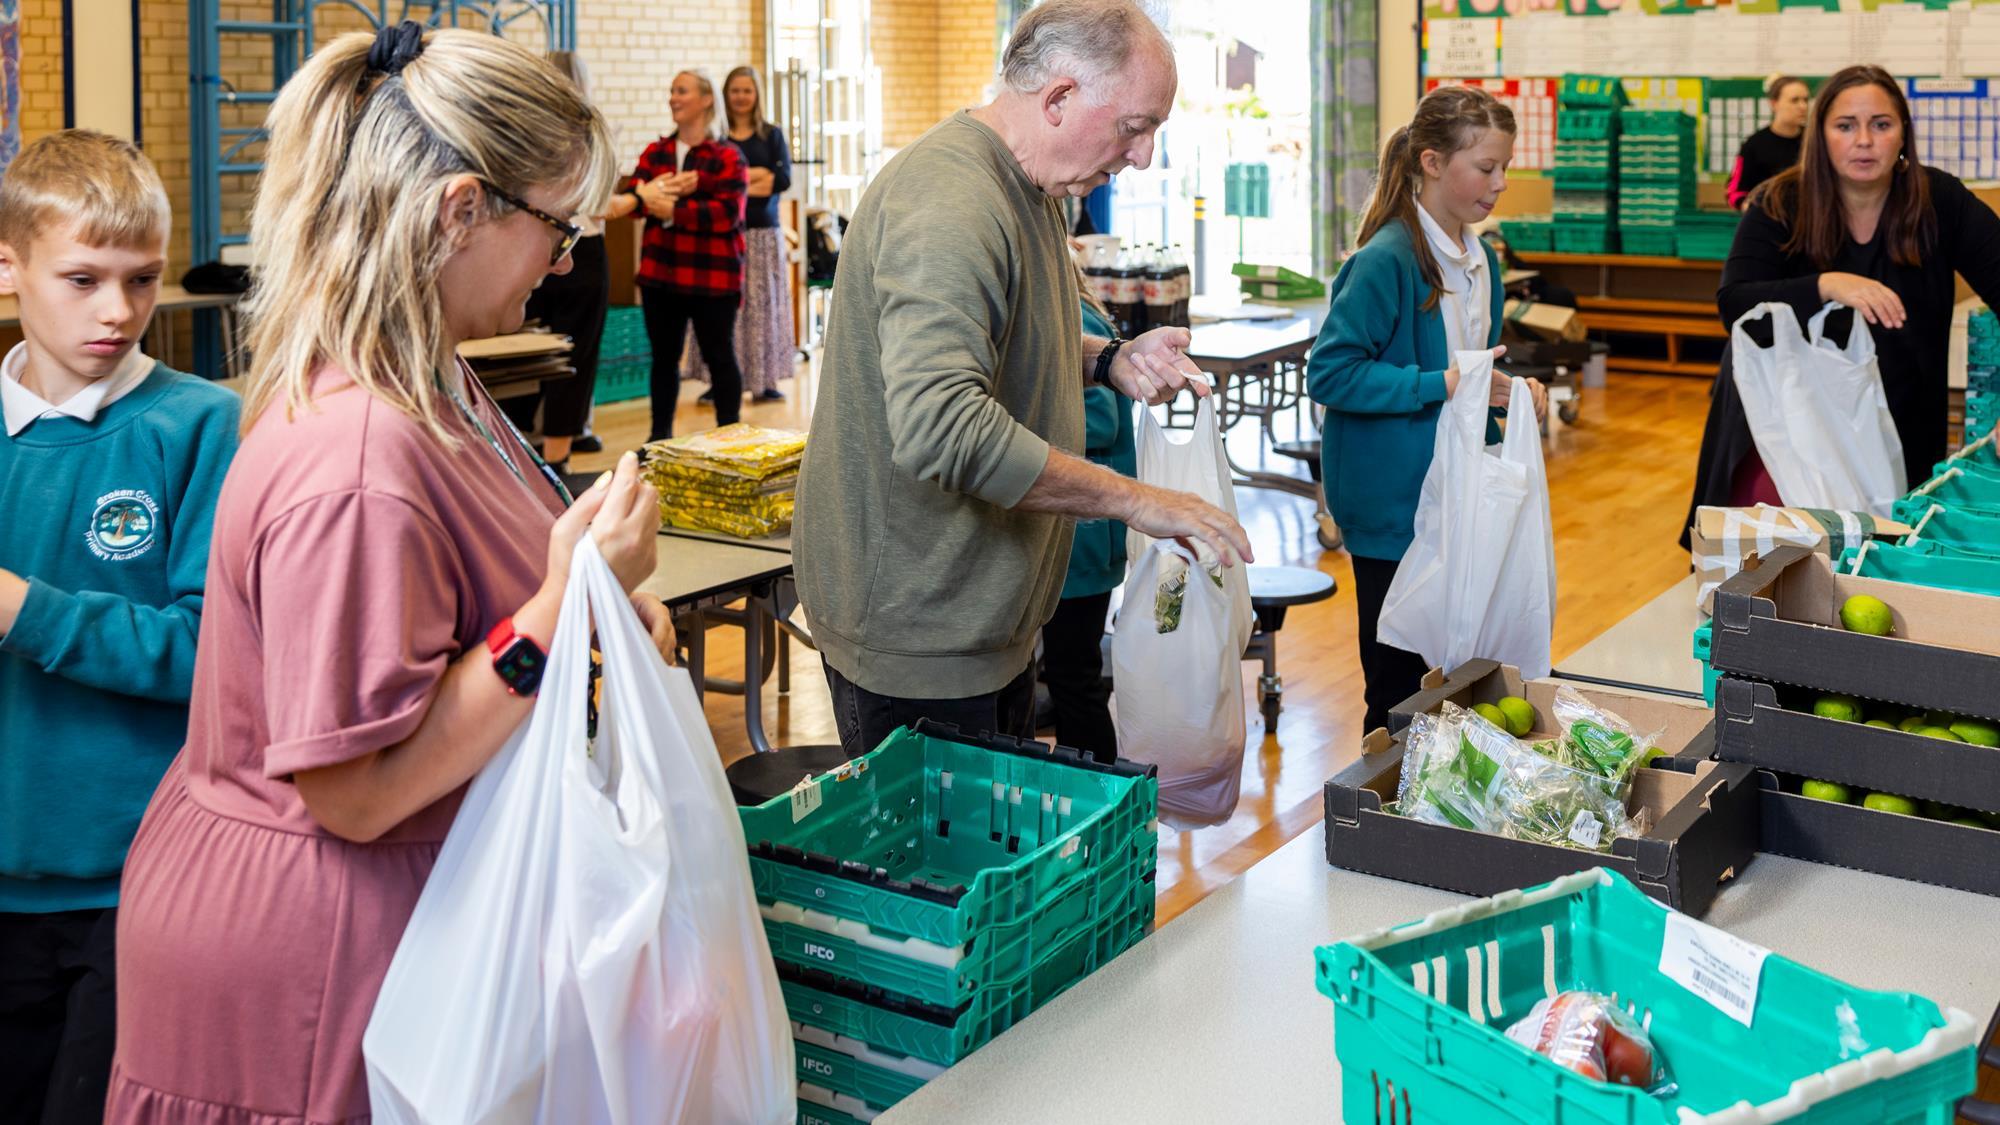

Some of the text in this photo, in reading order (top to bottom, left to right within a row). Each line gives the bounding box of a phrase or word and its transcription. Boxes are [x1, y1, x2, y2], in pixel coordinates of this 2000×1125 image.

[96, 489, 160, 513] Broken Cross
[83, 530, 111, 561] Primary
[804, 942, 835, 961] IFCO
[803, 1056, 832, 1076] IFCO
